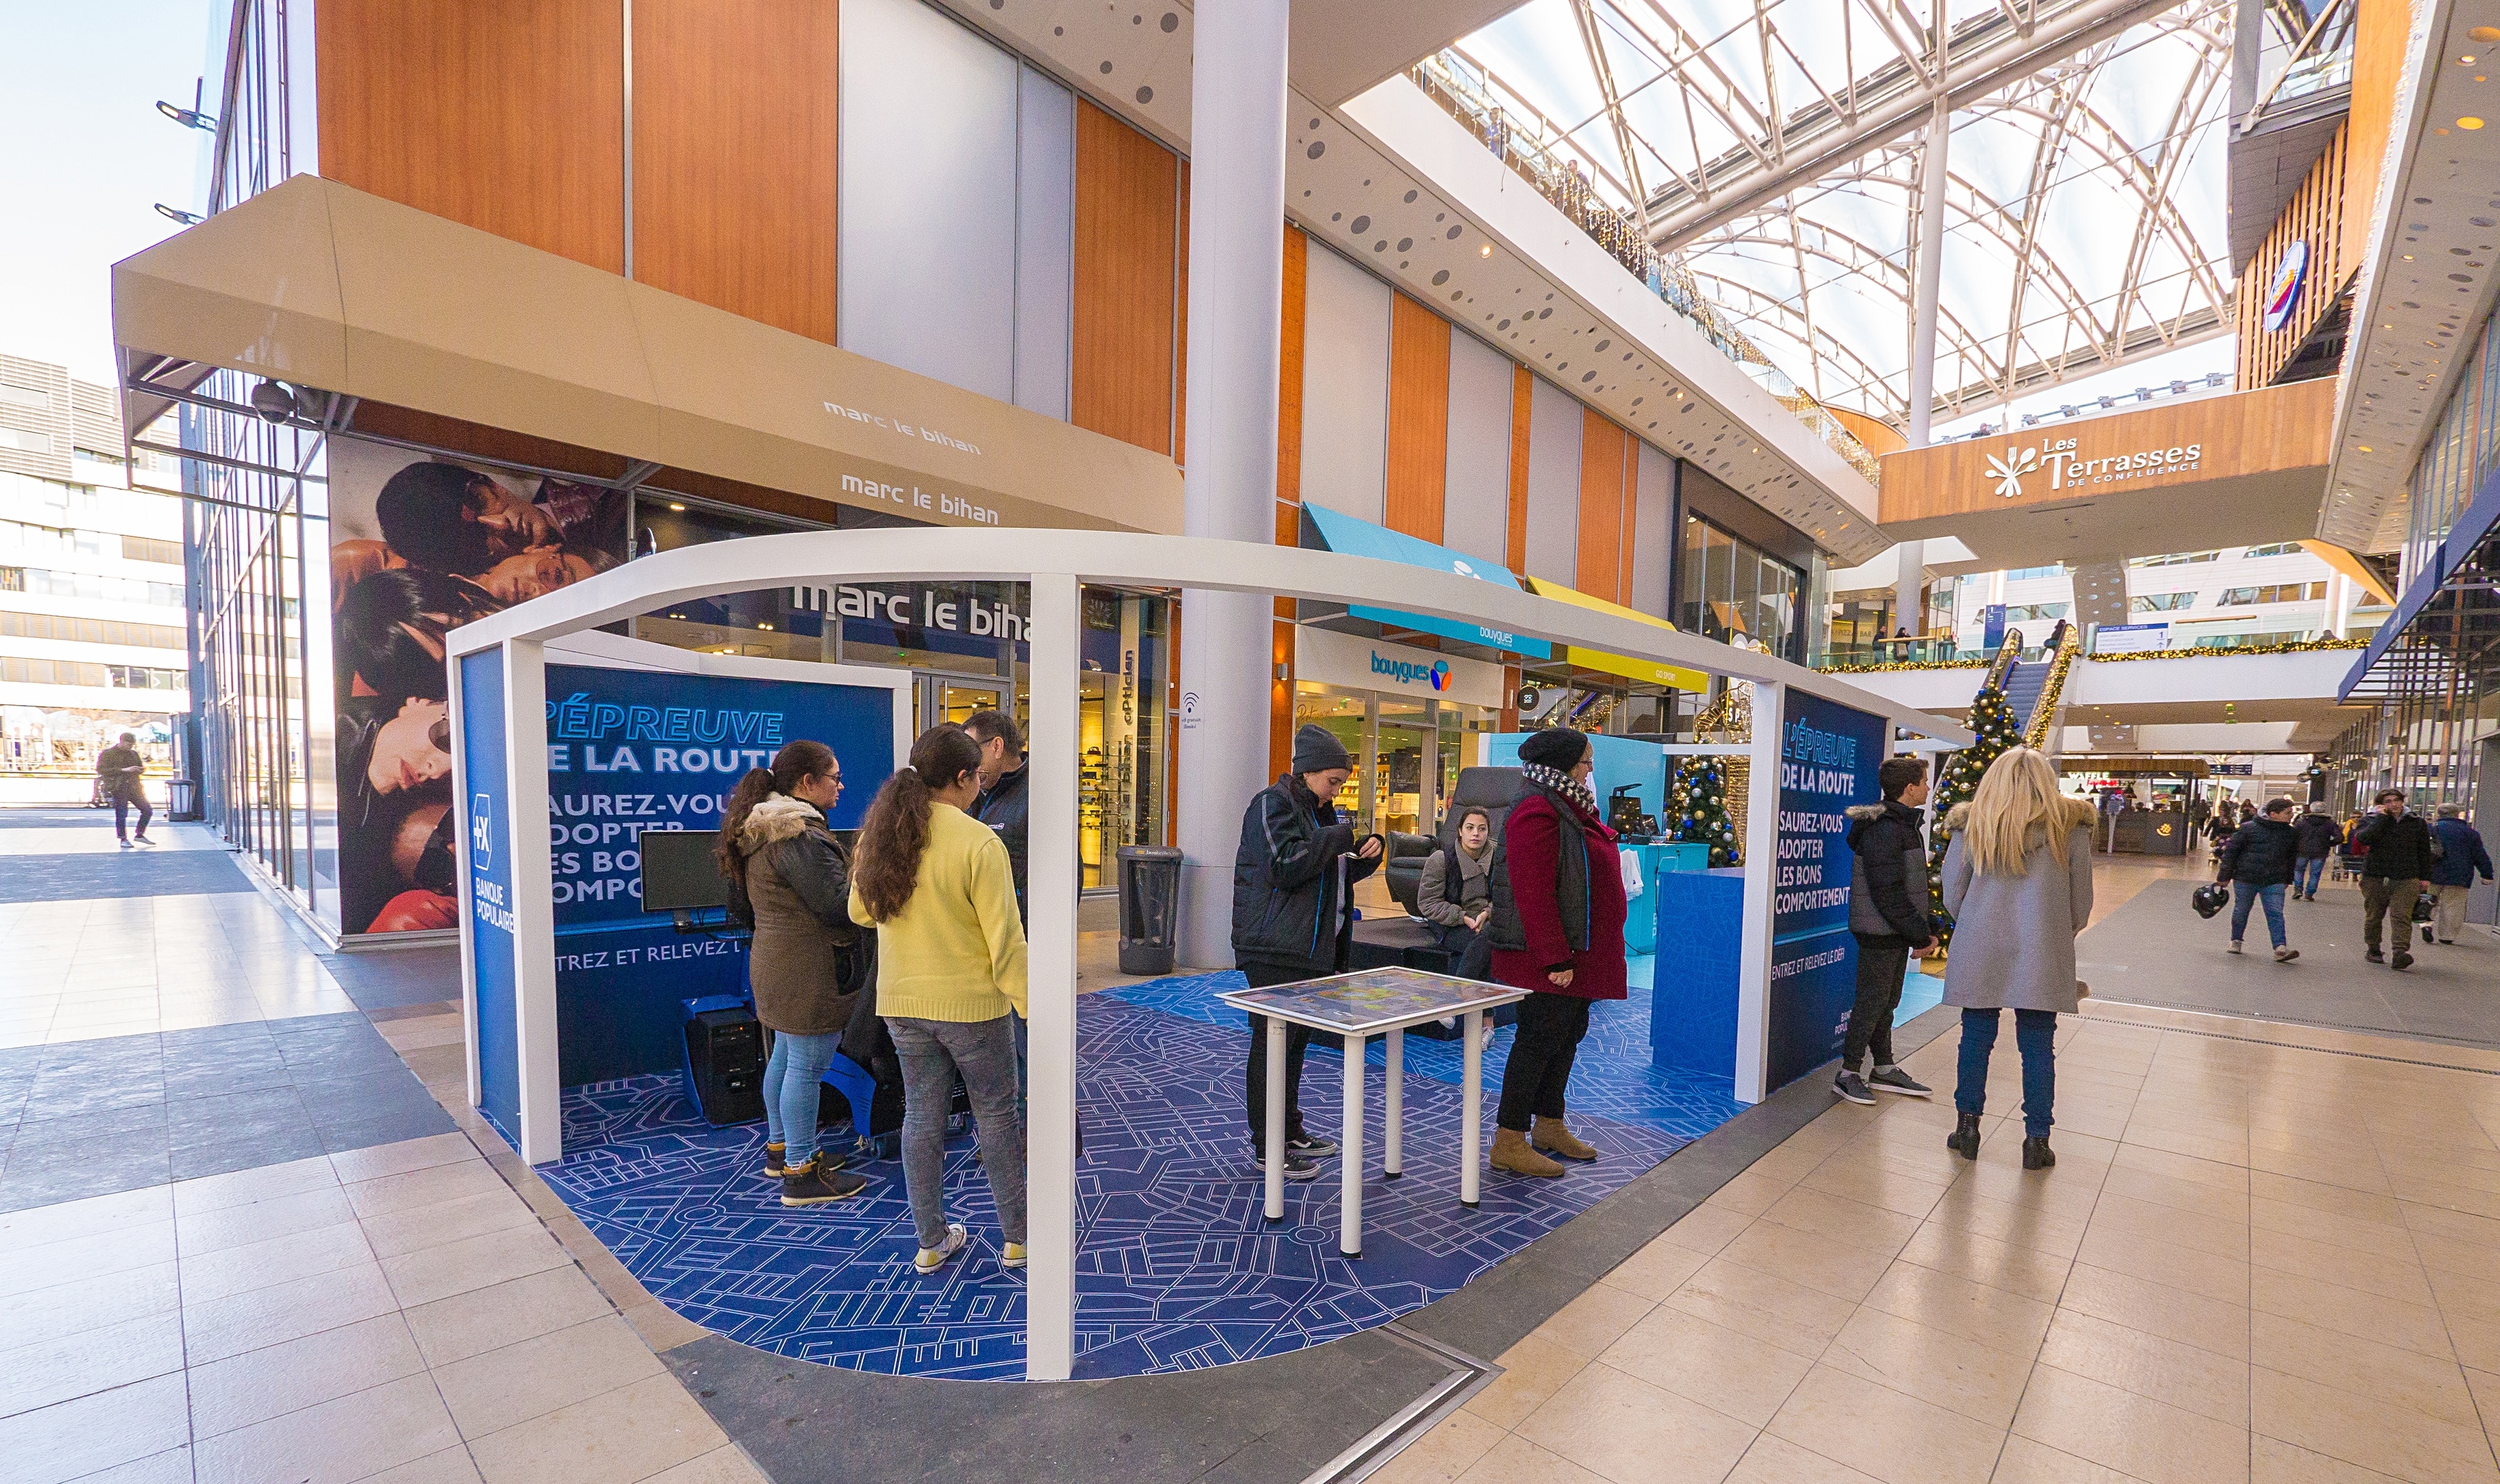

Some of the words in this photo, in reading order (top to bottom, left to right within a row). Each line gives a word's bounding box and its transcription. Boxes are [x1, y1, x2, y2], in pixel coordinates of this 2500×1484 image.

[824, 401, 888, 428] marc
[893, 419, 914, 437] le
[920, 427, 982, 456] bihan
[2043, 438, 2078, 453] Les
[2041, 443, 2201, 490] Terrasses
[2067, 478, 2086, 487] DE
[2093, 462, 2199, 484] CONFLUENCE
[841, 474, 904, 503] marc
[914, 487, 932, 510] le
[941, 493, 998, 525] bihan
[794, 585, 910, 624] marc
[925, 591, 957, 631] le
[970, 598, 1031, 642] bih
[1372, 650, 1430, 683] bouygues
[1656, 670, 1662, 678] GO
[546, 692, 785, 745] 'ÉPREUVE
[1782, 716, 1856, 769] L'ÉPREUVE
[548, 744, 571, 772] E
[585, 745, 642, 773] LA
[1781, 762, 1798, 790] DE
[1800, 767, 1816, 793] LA
[1819, 770, 1855, 797] ROUTE
[2067, 771, 2110, 780] WAFFLE
[549, 795, 735, 816] AUREZ-VOU
[1779, 810, 1844, 833] SAUREZ-VOUS
[1777, 839, 1824, 859] ADOPTER
[1777, 866, 1795, 887] LES
[1796, 865, 1822, 886] BONS
[475, 877, 504, 906] BANQUE
[1775, 887, 1850, 915] COMPORTEMENT
[477, 899, 514, 934] POPULAIRE
[555, 952, 609, 972] TREZ
[616, 949, 640, 965] ET
[647, 941, 728, 962] RELEVEZ
[1772, 960, 1795, 981] ENTREZ
[1796, 958, 1804, 973] ET
[1805, 952, 1827, 971] RELEVEZ
[1827, 950, 1833, 964] LE
